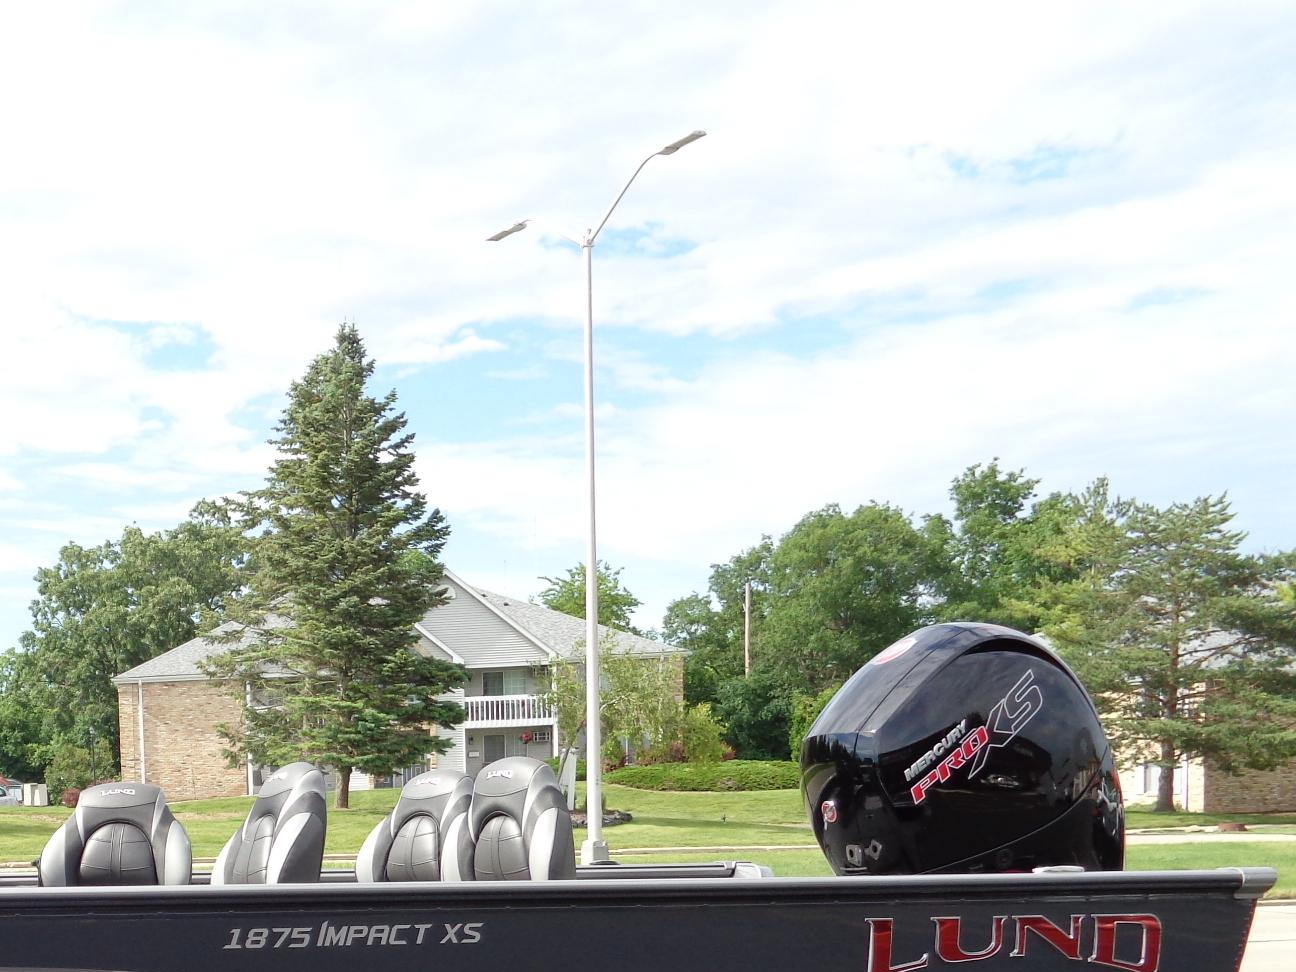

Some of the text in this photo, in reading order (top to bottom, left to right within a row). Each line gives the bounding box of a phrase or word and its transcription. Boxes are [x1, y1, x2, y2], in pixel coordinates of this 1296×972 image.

[904, 718, 967, 782] MERCURY
[910, 725, 989, 805] PRO
[222, 920, 485, 949] 1875 IMPACT XS
